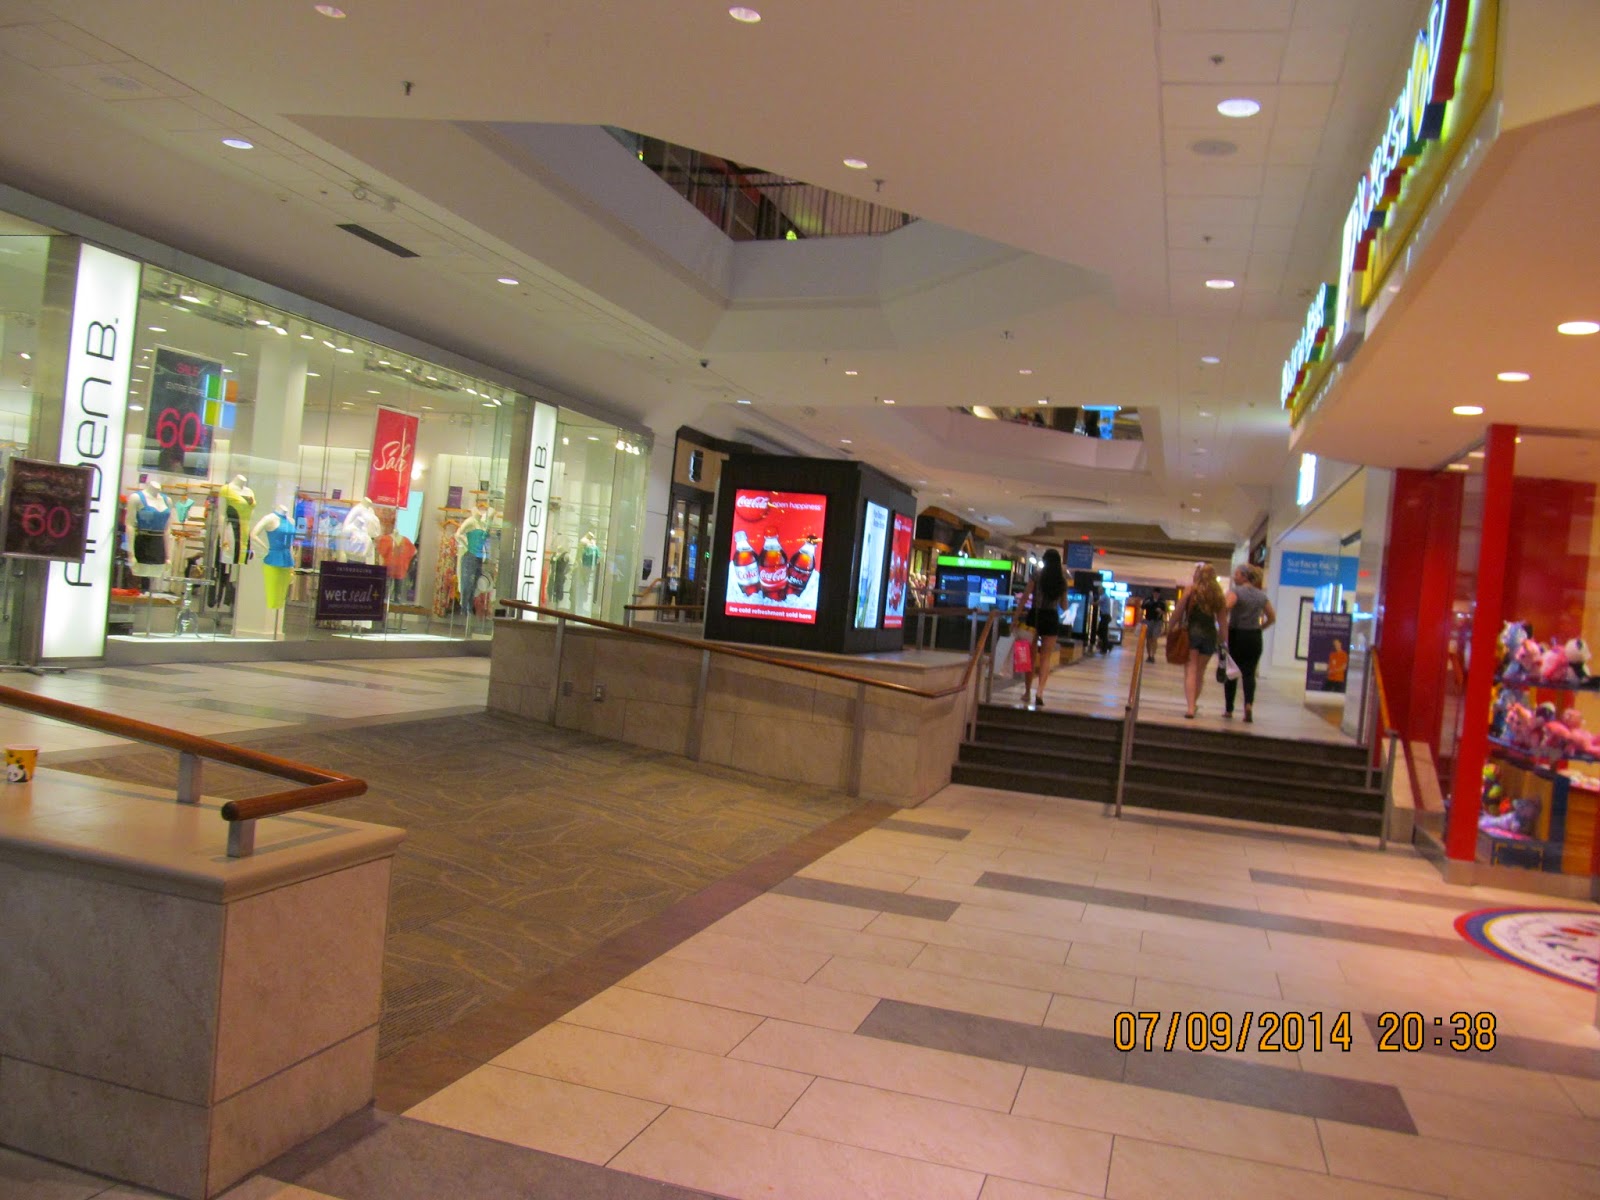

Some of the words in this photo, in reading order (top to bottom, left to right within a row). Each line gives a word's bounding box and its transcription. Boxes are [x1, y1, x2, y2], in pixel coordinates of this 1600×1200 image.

[155, 407, 201, 452] 60
[373, 428, 411, 472] Sale
[21, 503, 71, 538] 60
[324, 589, 348, 602] wet
